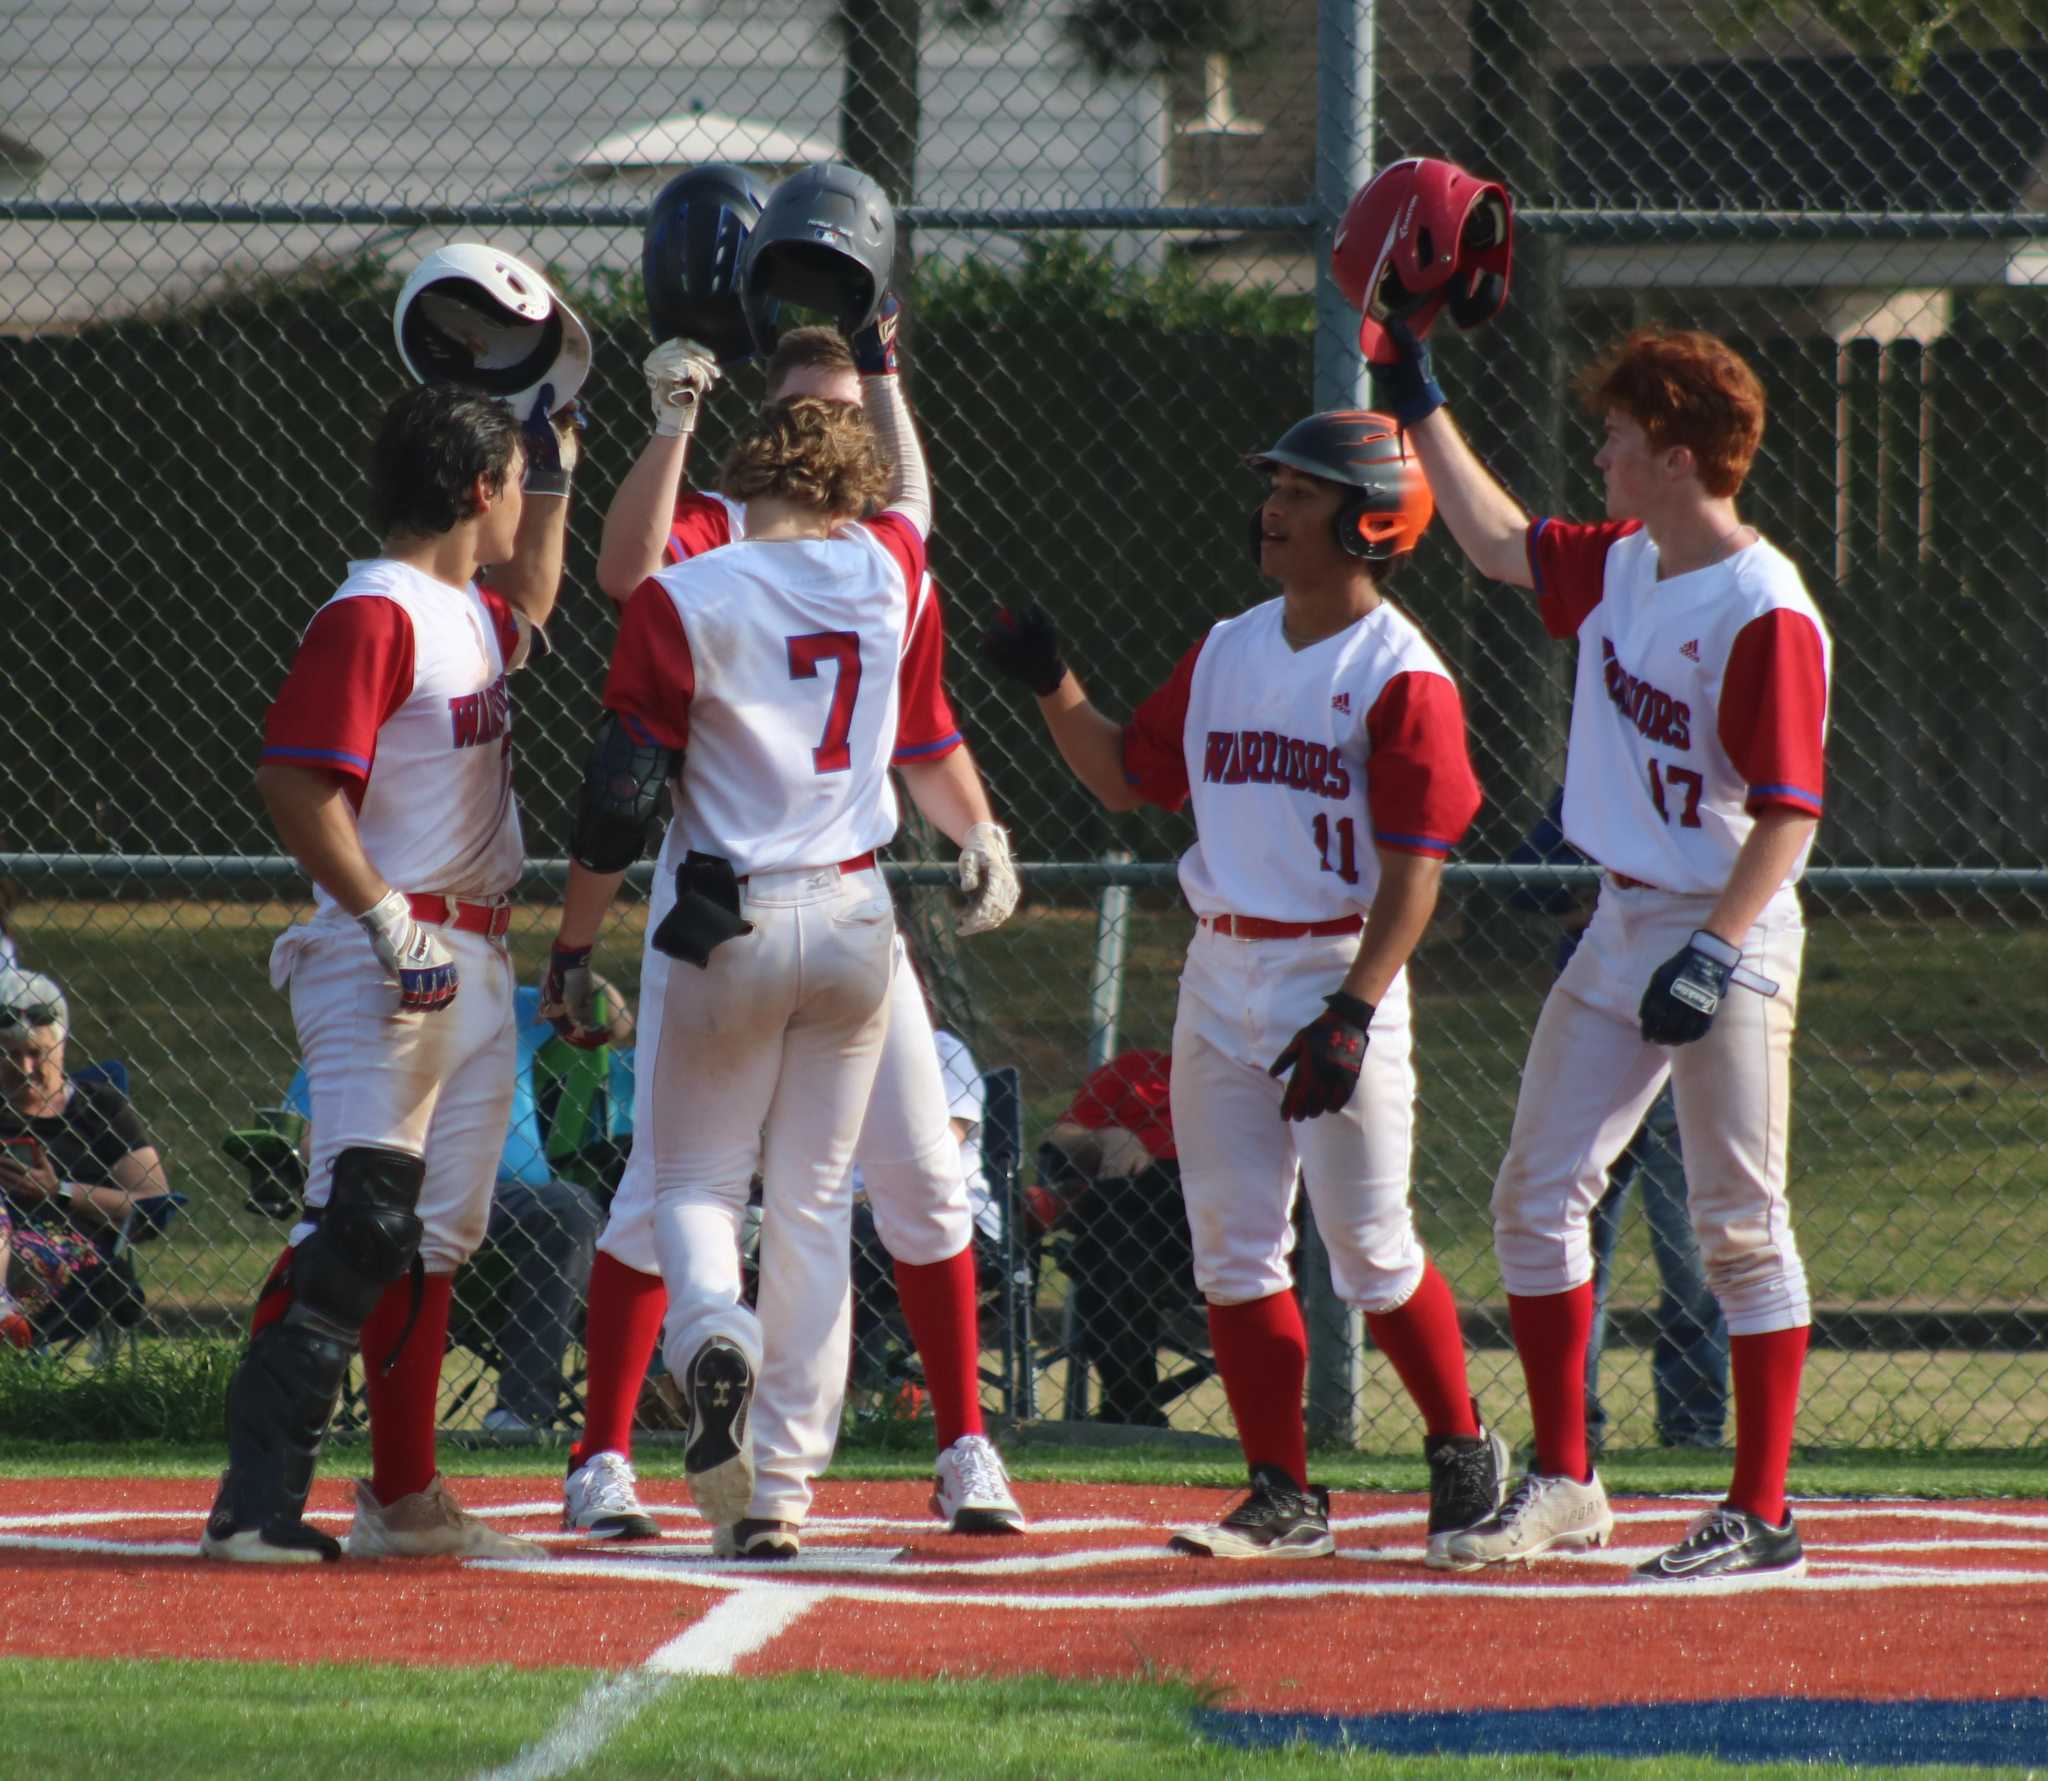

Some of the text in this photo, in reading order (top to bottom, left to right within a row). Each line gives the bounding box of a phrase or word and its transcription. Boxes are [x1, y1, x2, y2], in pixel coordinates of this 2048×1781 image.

[785, 631, 862, 775] 7
[1203, 731, 1350, 801] WARRIORS
[1647, 758, 1703, 829] 17
[1312, 812, 1359, 885] 11
